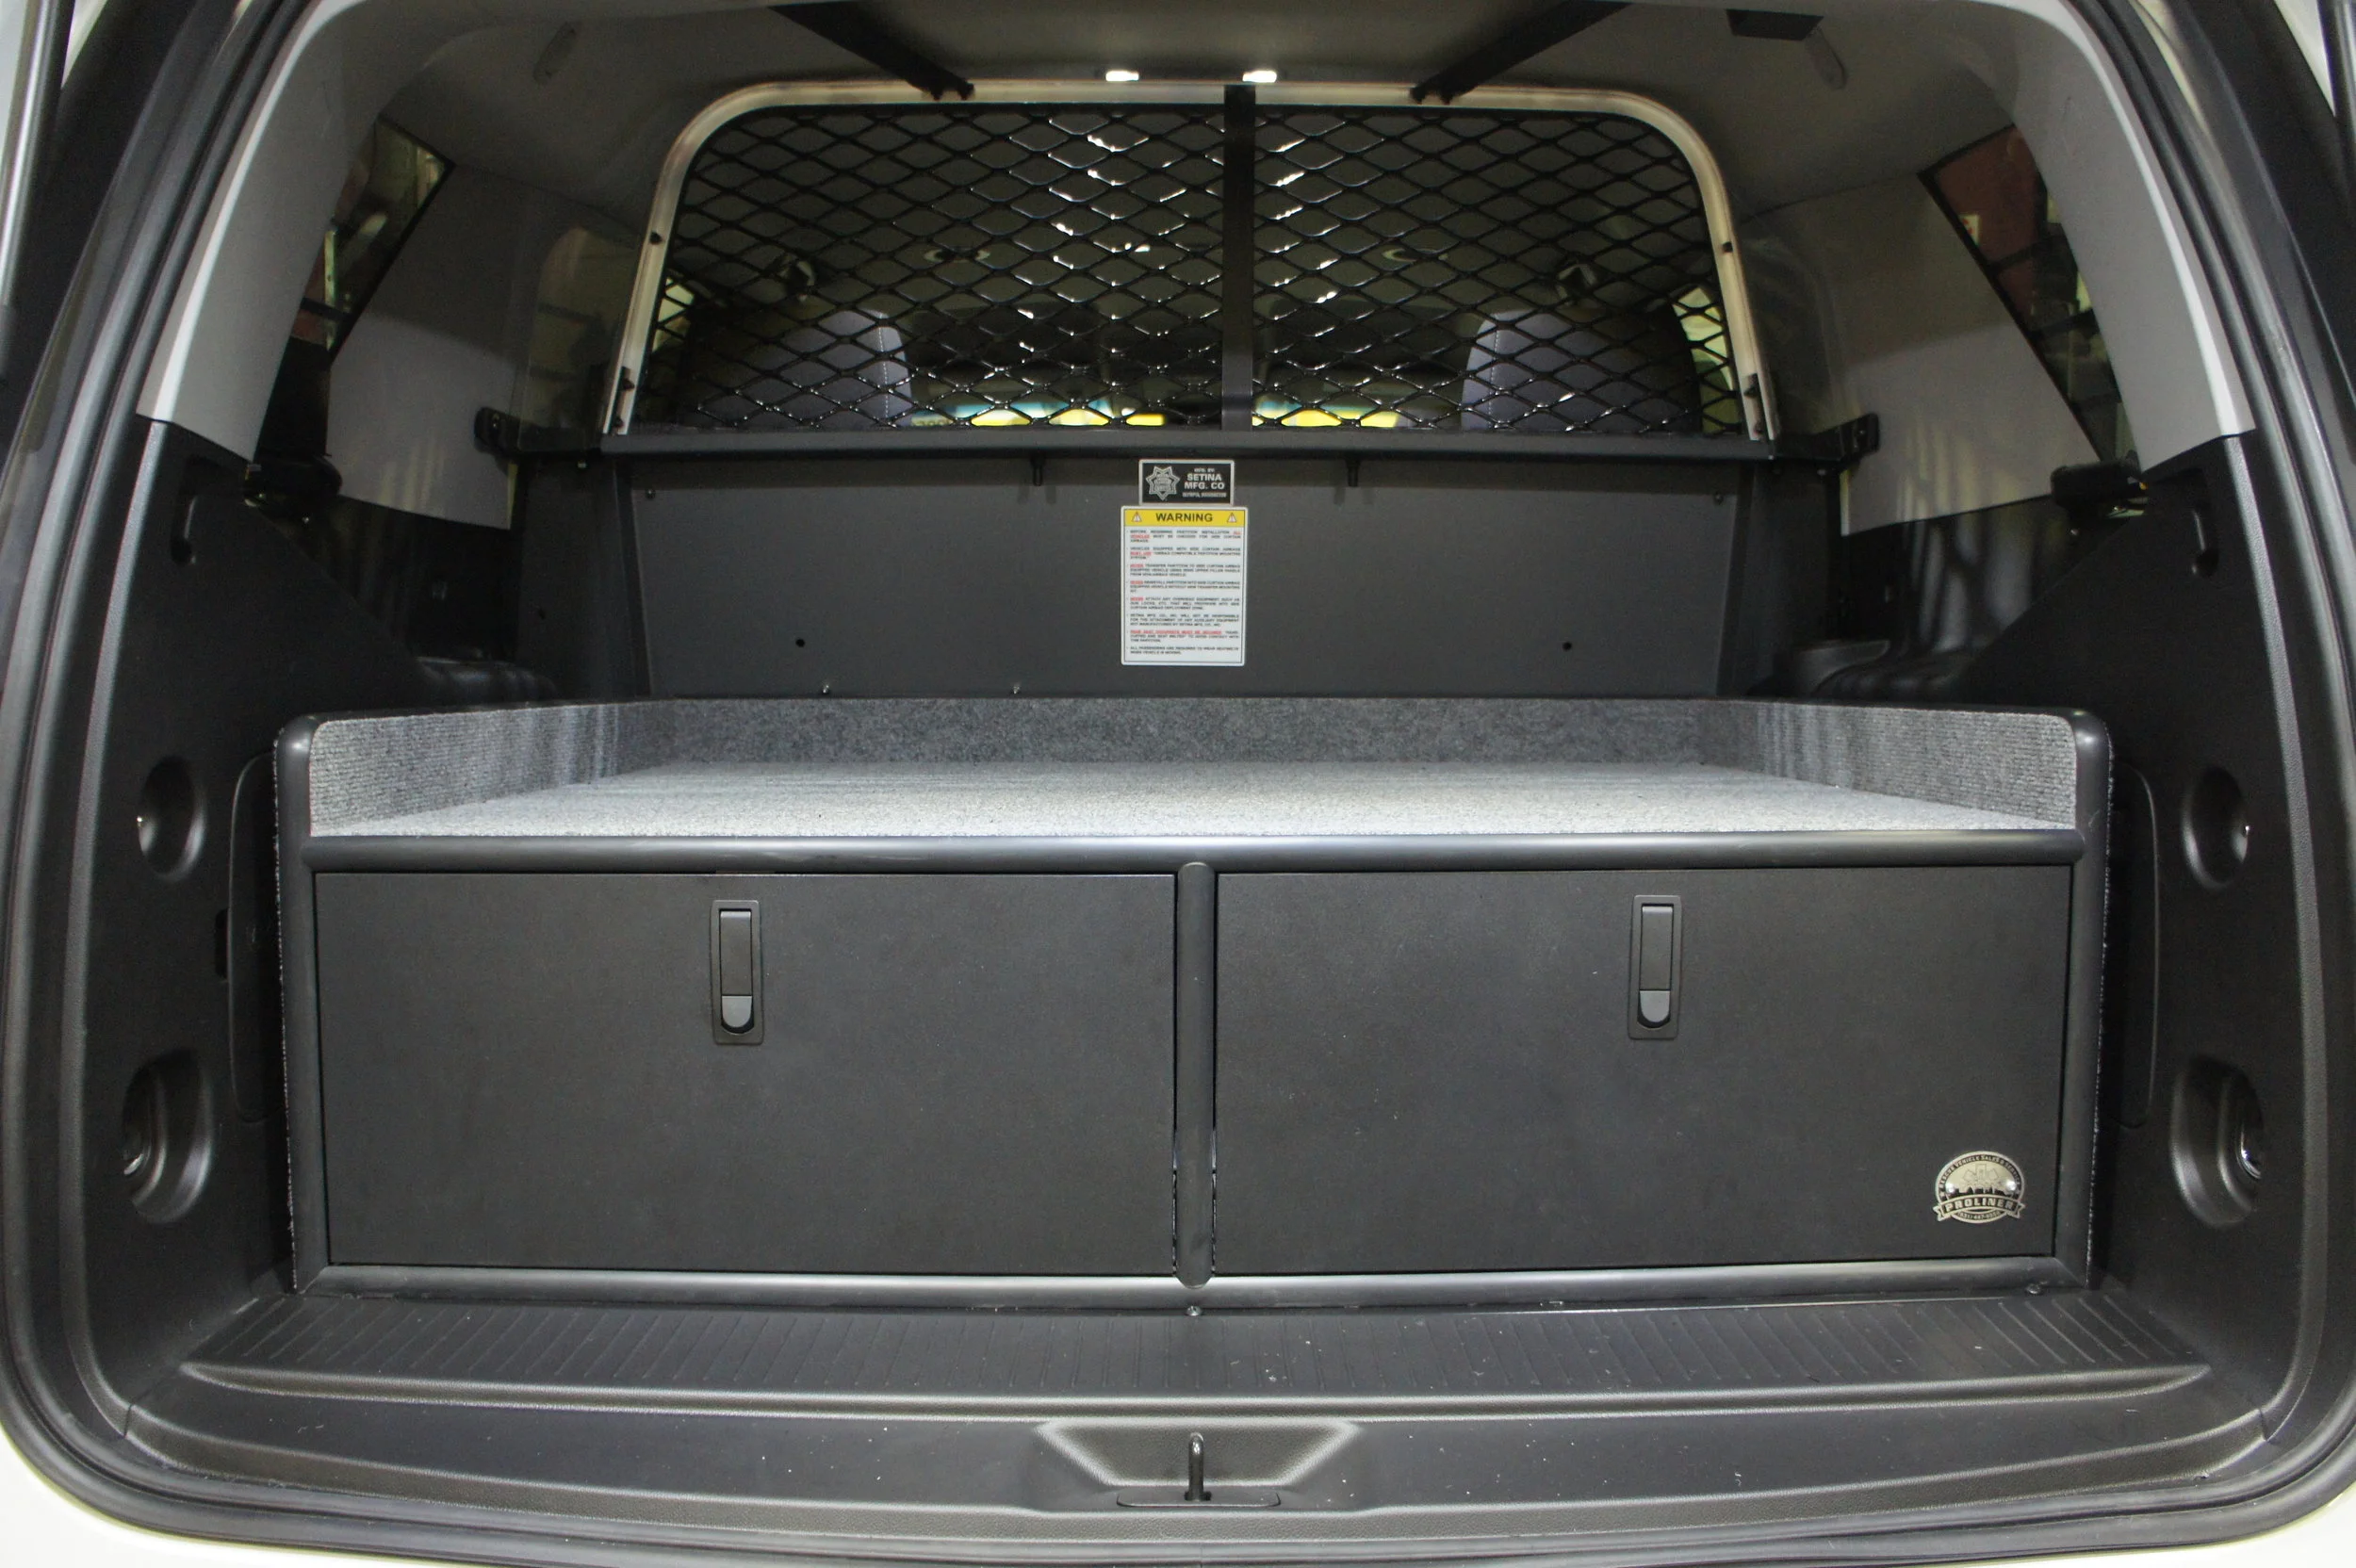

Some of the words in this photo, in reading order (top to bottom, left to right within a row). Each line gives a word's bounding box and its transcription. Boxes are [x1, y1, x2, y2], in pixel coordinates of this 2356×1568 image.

[1186, 473, 1222, 482] SETINA
[1184, 482, 1208, 490] MFG.
[1210, 482, 1225, 490] CO
[1155, 513, 1214, 523] WARNING
[1945, 1198, 2014, 1213] PROLINER
